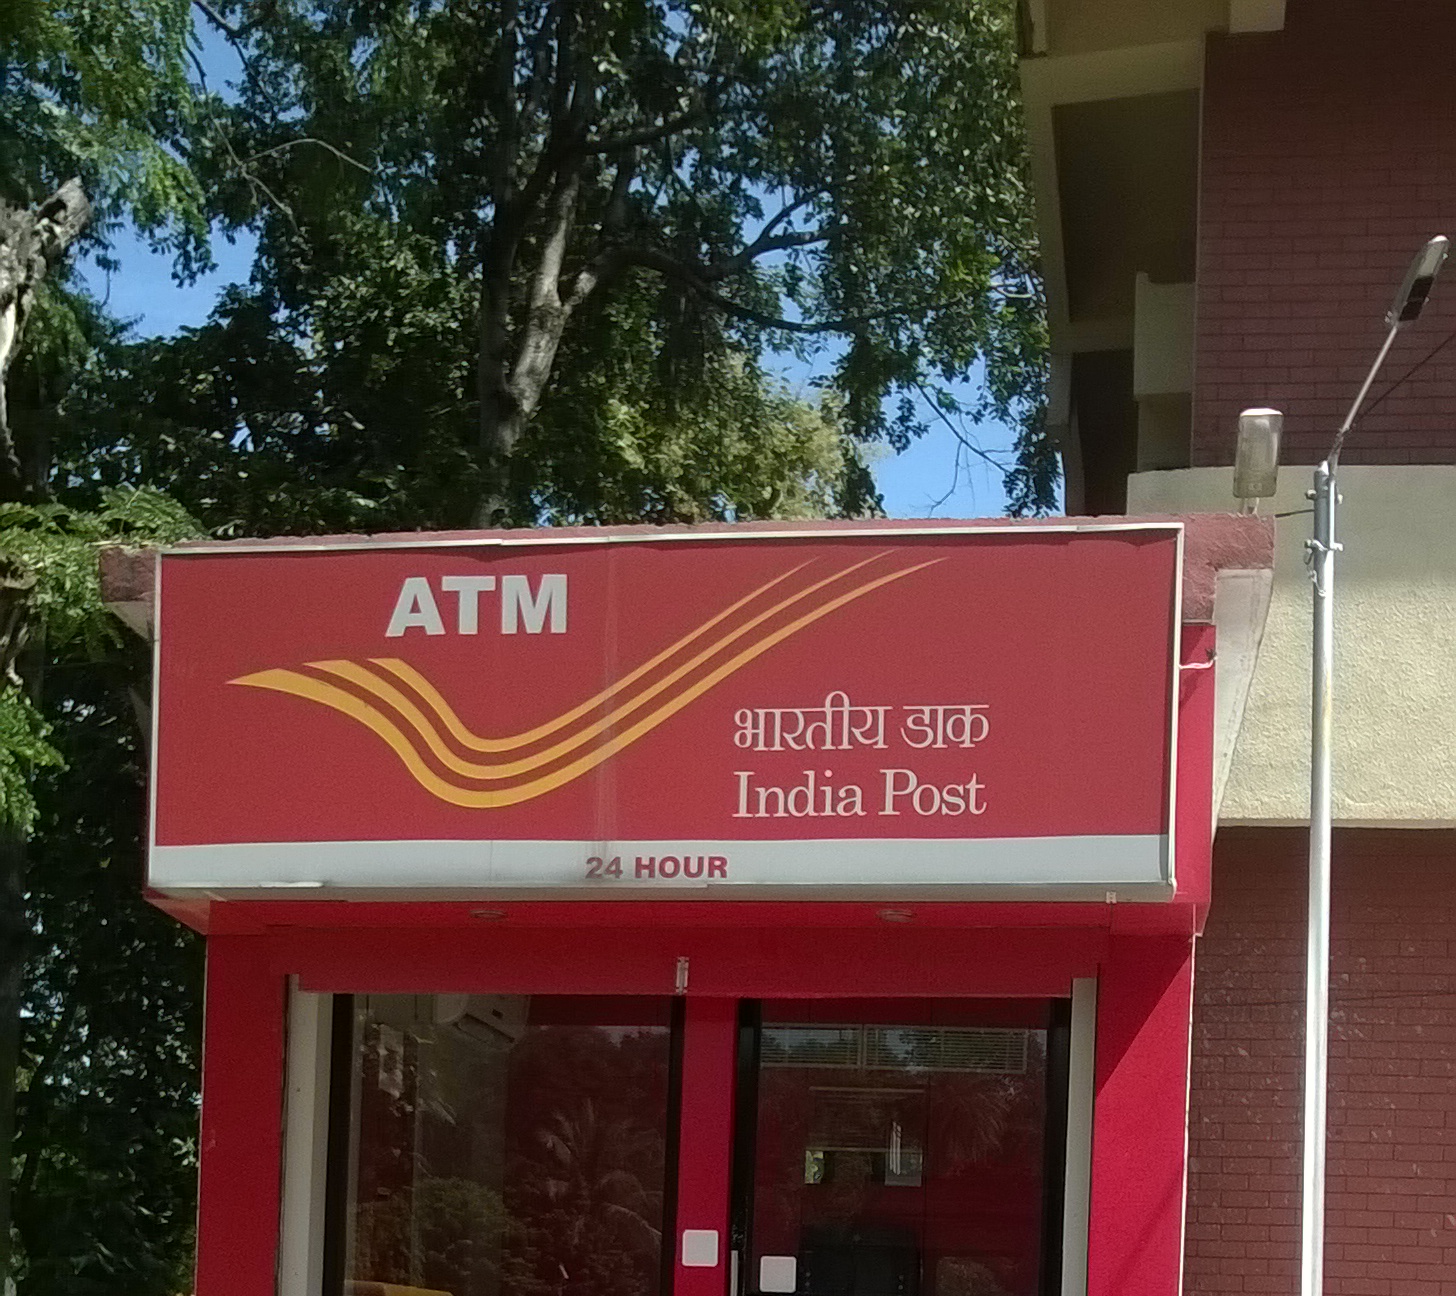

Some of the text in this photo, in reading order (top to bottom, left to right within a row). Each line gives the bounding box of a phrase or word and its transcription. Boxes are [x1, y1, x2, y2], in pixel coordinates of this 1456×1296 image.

[386, 574, 567, 636] ATM
[734, 690, 990, 751] भारतीय डाक
[733, 769, 987, 817] India Post
[585, 856, 728, 879] 24 HOUR
